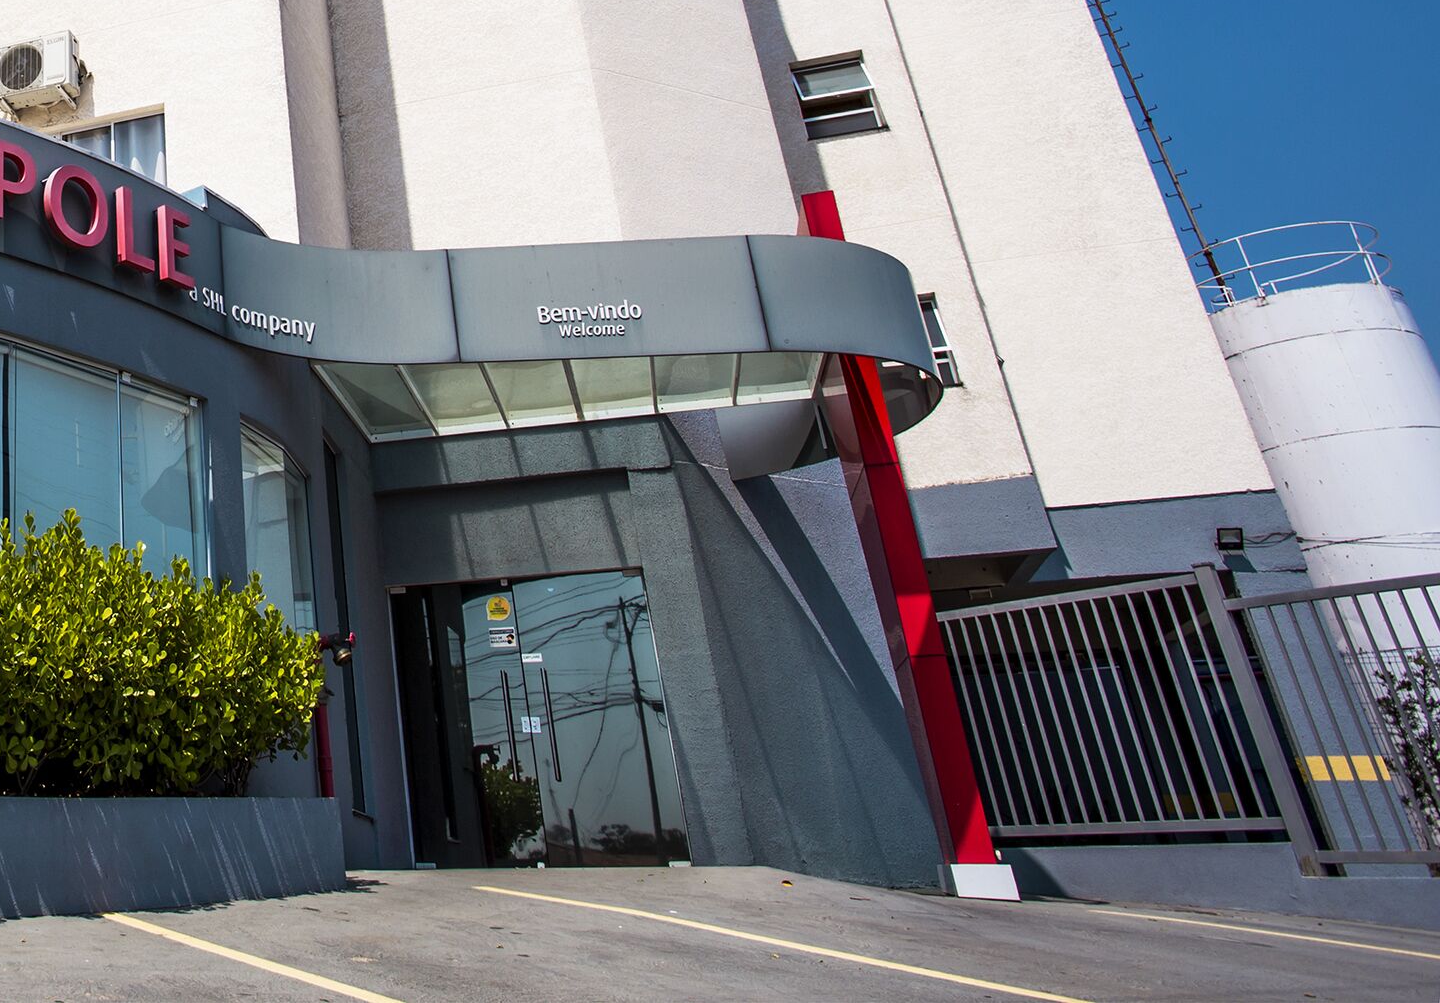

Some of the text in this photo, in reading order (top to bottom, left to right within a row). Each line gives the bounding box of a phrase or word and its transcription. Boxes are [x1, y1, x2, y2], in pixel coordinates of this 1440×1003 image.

[189, 286, 315, 342] a SHL company
[537, 299, 642, 323] Bem-vindo
[559, 322, 625, 337] Welcome
